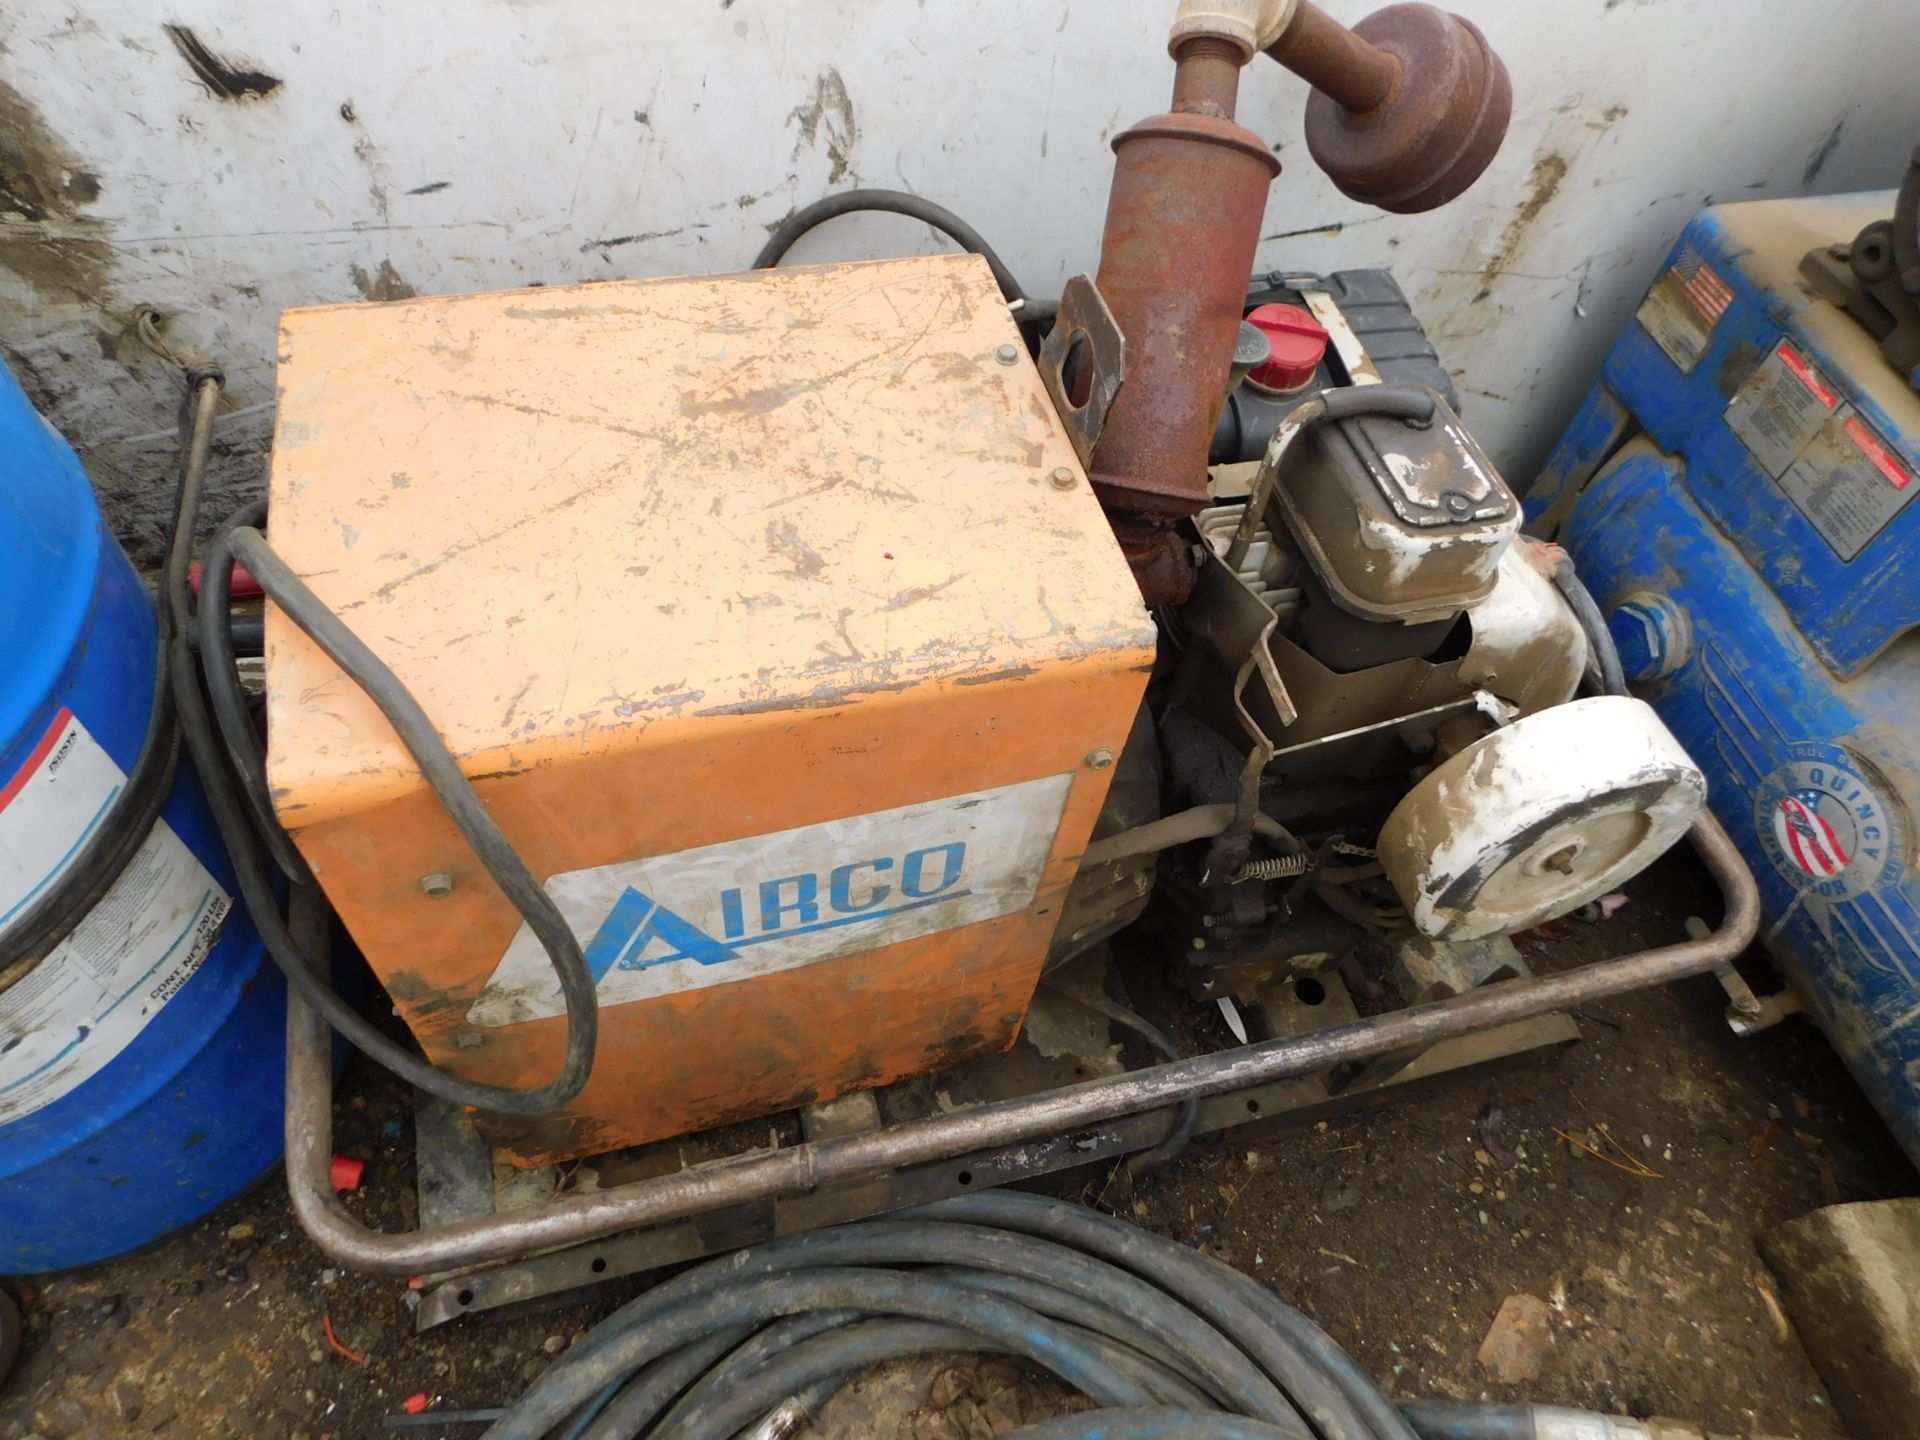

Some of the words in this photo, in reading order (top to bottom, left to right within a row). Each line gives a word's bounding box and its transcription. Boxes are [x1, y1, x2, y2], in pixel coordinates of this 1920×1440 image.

[1809, 767, 1881, 861] QUINCY
[197, 914, 211, 934] 120
[208, 896, 222, 915] Lbs
[554, 841, 967, 996] AIRCO
[182, 945, 202, 967] NET
